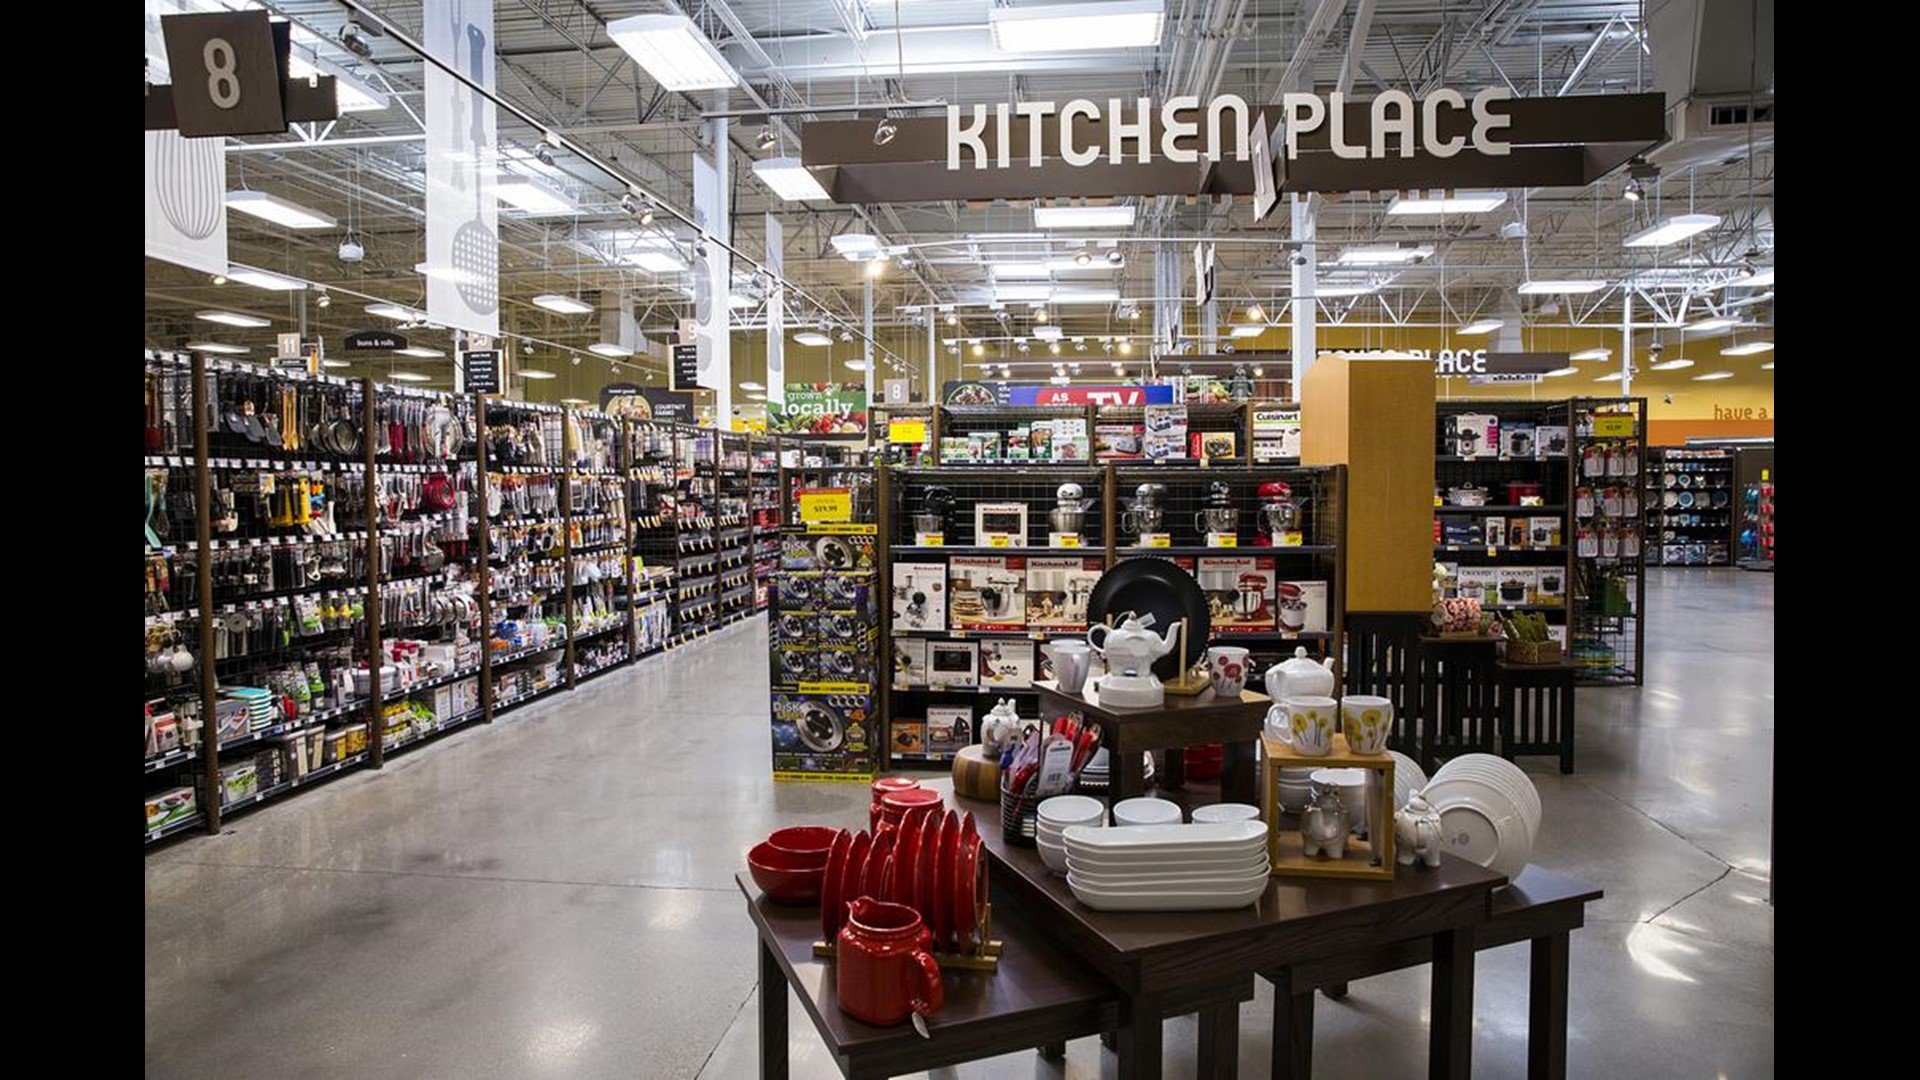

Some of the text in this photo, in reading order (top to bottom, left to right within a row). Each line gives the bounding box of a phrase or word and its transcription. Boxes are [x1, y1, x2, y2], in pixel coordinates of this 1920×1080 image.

[203, 37, 241, 110] 8
[946, 87, 1512, 170] KITCHEN PLACE
[283, 337, 295, 353] 11
[787, 392, 822, 401] grown
[891, 383, 902, 399] 8
[1051, 392, 1069, 402] AS
[780, 399, 853, 418] locally
[1714, 403, 1767, 420] have a
[1256, 413, 1298, 421] Cuisinart
[954, 558, 1001, 566] KitchenAid
[1031, 560, 1078, 568] KitchenAid
